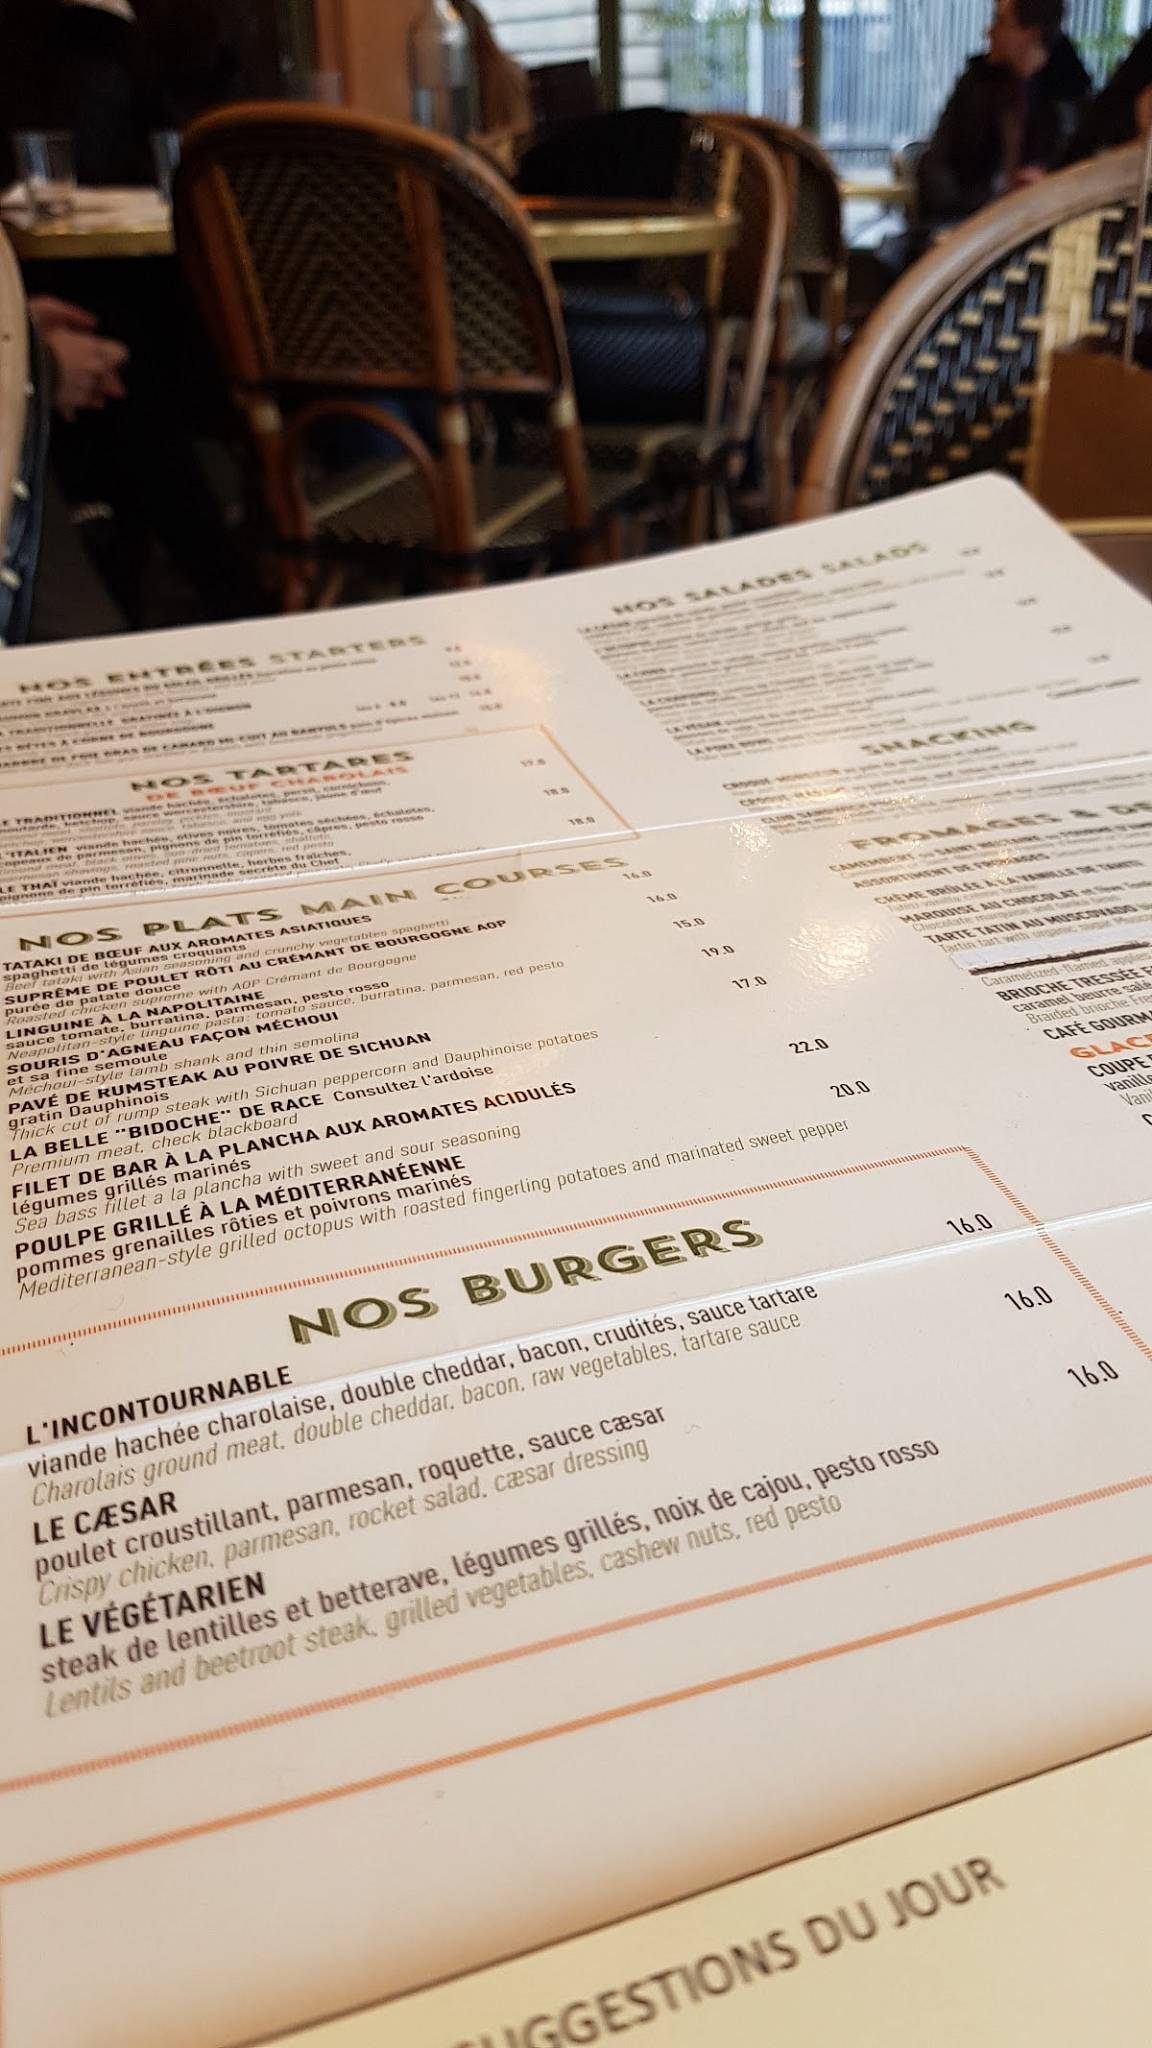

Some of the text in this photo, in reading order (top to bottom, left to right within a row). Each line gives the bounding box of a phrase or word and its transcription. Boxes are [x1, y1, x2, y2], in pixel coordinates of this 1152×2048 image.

[612, 596, 675, 615] NOS
[685, 567, 812, 602] SALADES
[821, 542, 927, 573] SALADS
[19, 678, 94, 694] NOS
[107, 656, 256, 683] ENTRÉES
[269, 635, 426, 663] STARTERS
[861, 720, 1036, 756] SNACKING
[131, 751, 414, 791] NOS TARTARES
[146, 790, 179, 801] DE
[271, 766, 408, 788] CHAROLAIS
[849, 812, 1062, 850] FROMAGES
[620, 870, 654, 880] 16.0
[19, 926, 121, 952] NOS
[144, 908, 283, 938] PLATS
[300, 889, 417, 916] MAIN
[433, 857, 629, 895] COURSES
[646, 892, 679, 903] 16.0
[899, 889, 1079, 924] MARQUISE AU CHOCOLAT
[1, 956, 62, 973] TATAKI
[66, 953, 89, 964] DE
[147, 941, 182, 954] AUX
[185, 928, 276, 949] AROMATES
[277, 914, 373, 935] ASIATIQUES
[671, 917, 707, 929] 15.0
[923, 904, 1139, 944] TARTE TATIN AU MUSCOVADO
[3, 919, 509, 1005] SUPRÊME DE POULET RÔTI AU CRÉMANT DE BOURGOGNE AOP
[699, 944, 736, 957] 19.0
[729, 975, 769, 989] 17.0
[996, 968, 1145, 1002] BRIOCHE TRESSÉE
[5, 990, 265, 1039] LINGUINE À LA NAPOLITAINE
[5, 981, 390, 1050] sauce tomate, burratina, parmesan, pesto rosso
[1043, 1020, 1092, 1040] CAFÉ
[6, 1011, 339, 1074] SOURIS D'AGNEAU FAÇON MÉCHOUI
[786, 1037, 831, 1054] 22.0
[7, 1032, 432, 1114] PAVÉ DE RUMSTEAK AU POIVRE DE SICHUAN
[1087, 1056, 1151, 1077] COUPE
[7, 1091, 170, 1130] gratin Dauphinois
[828, 1080, 873, 1098] 20.0
[9, 1144, 38, 1161] LA
[43, 1131, 109, 1155] BELLE
[237, 1103, 266, 1119] DE
[269, 1093, 324, 1113] RACE
[331, 1079, 419, 1102] Consultez
[419, 1066, 495, 1086] l'ardoise
[11, 1081, 578, 1198] FILET DE BAR À LA PLANCHA AUX AROMATES ACIDULÉS
[11, 1158, 252, 1214] légumes grillés marinés
[14, 1155, 465, 1258] POULPE GRILLÉ À LA MÉDITERRANÉENNE
[15, 1174, 473, 1280] pommes grenailles rôties et poivrons marinés
[943, 1212, 996, 1236] 16.0
[289, 1218, 763, 1345] NOS BURGERS
[1001, 1284, 1057, 1311] 16.0
[26, 1284, 820, 1479] viande hachée charolaise, double cheddar, bacon, crudités, sauce tartare
[1064, 1359, 1123, 1388] 16.0
[25, 1365, 292, 1446] L'INCONTOURNABLE
[34, 1533, 117, 1583] poulet
[123, 1497, 278, 1554] croustillant,
[284, 1472, 407, 1520] parmesan,
[416, 1441, 526, 1482] roquette,
[526, 1424, 597, 1454] sauce
[32, 1516, 65, 1546] LE
[40, 1440, 942, 1686] steak de lentilles et betterave, légumes grillés, noix de cajou, pesto rosso
[38, 1570, 266, 1652] LE VÉGÉTARIEN
[454, 1855, 1007, 2048] GGESTIONS DU JOUR
